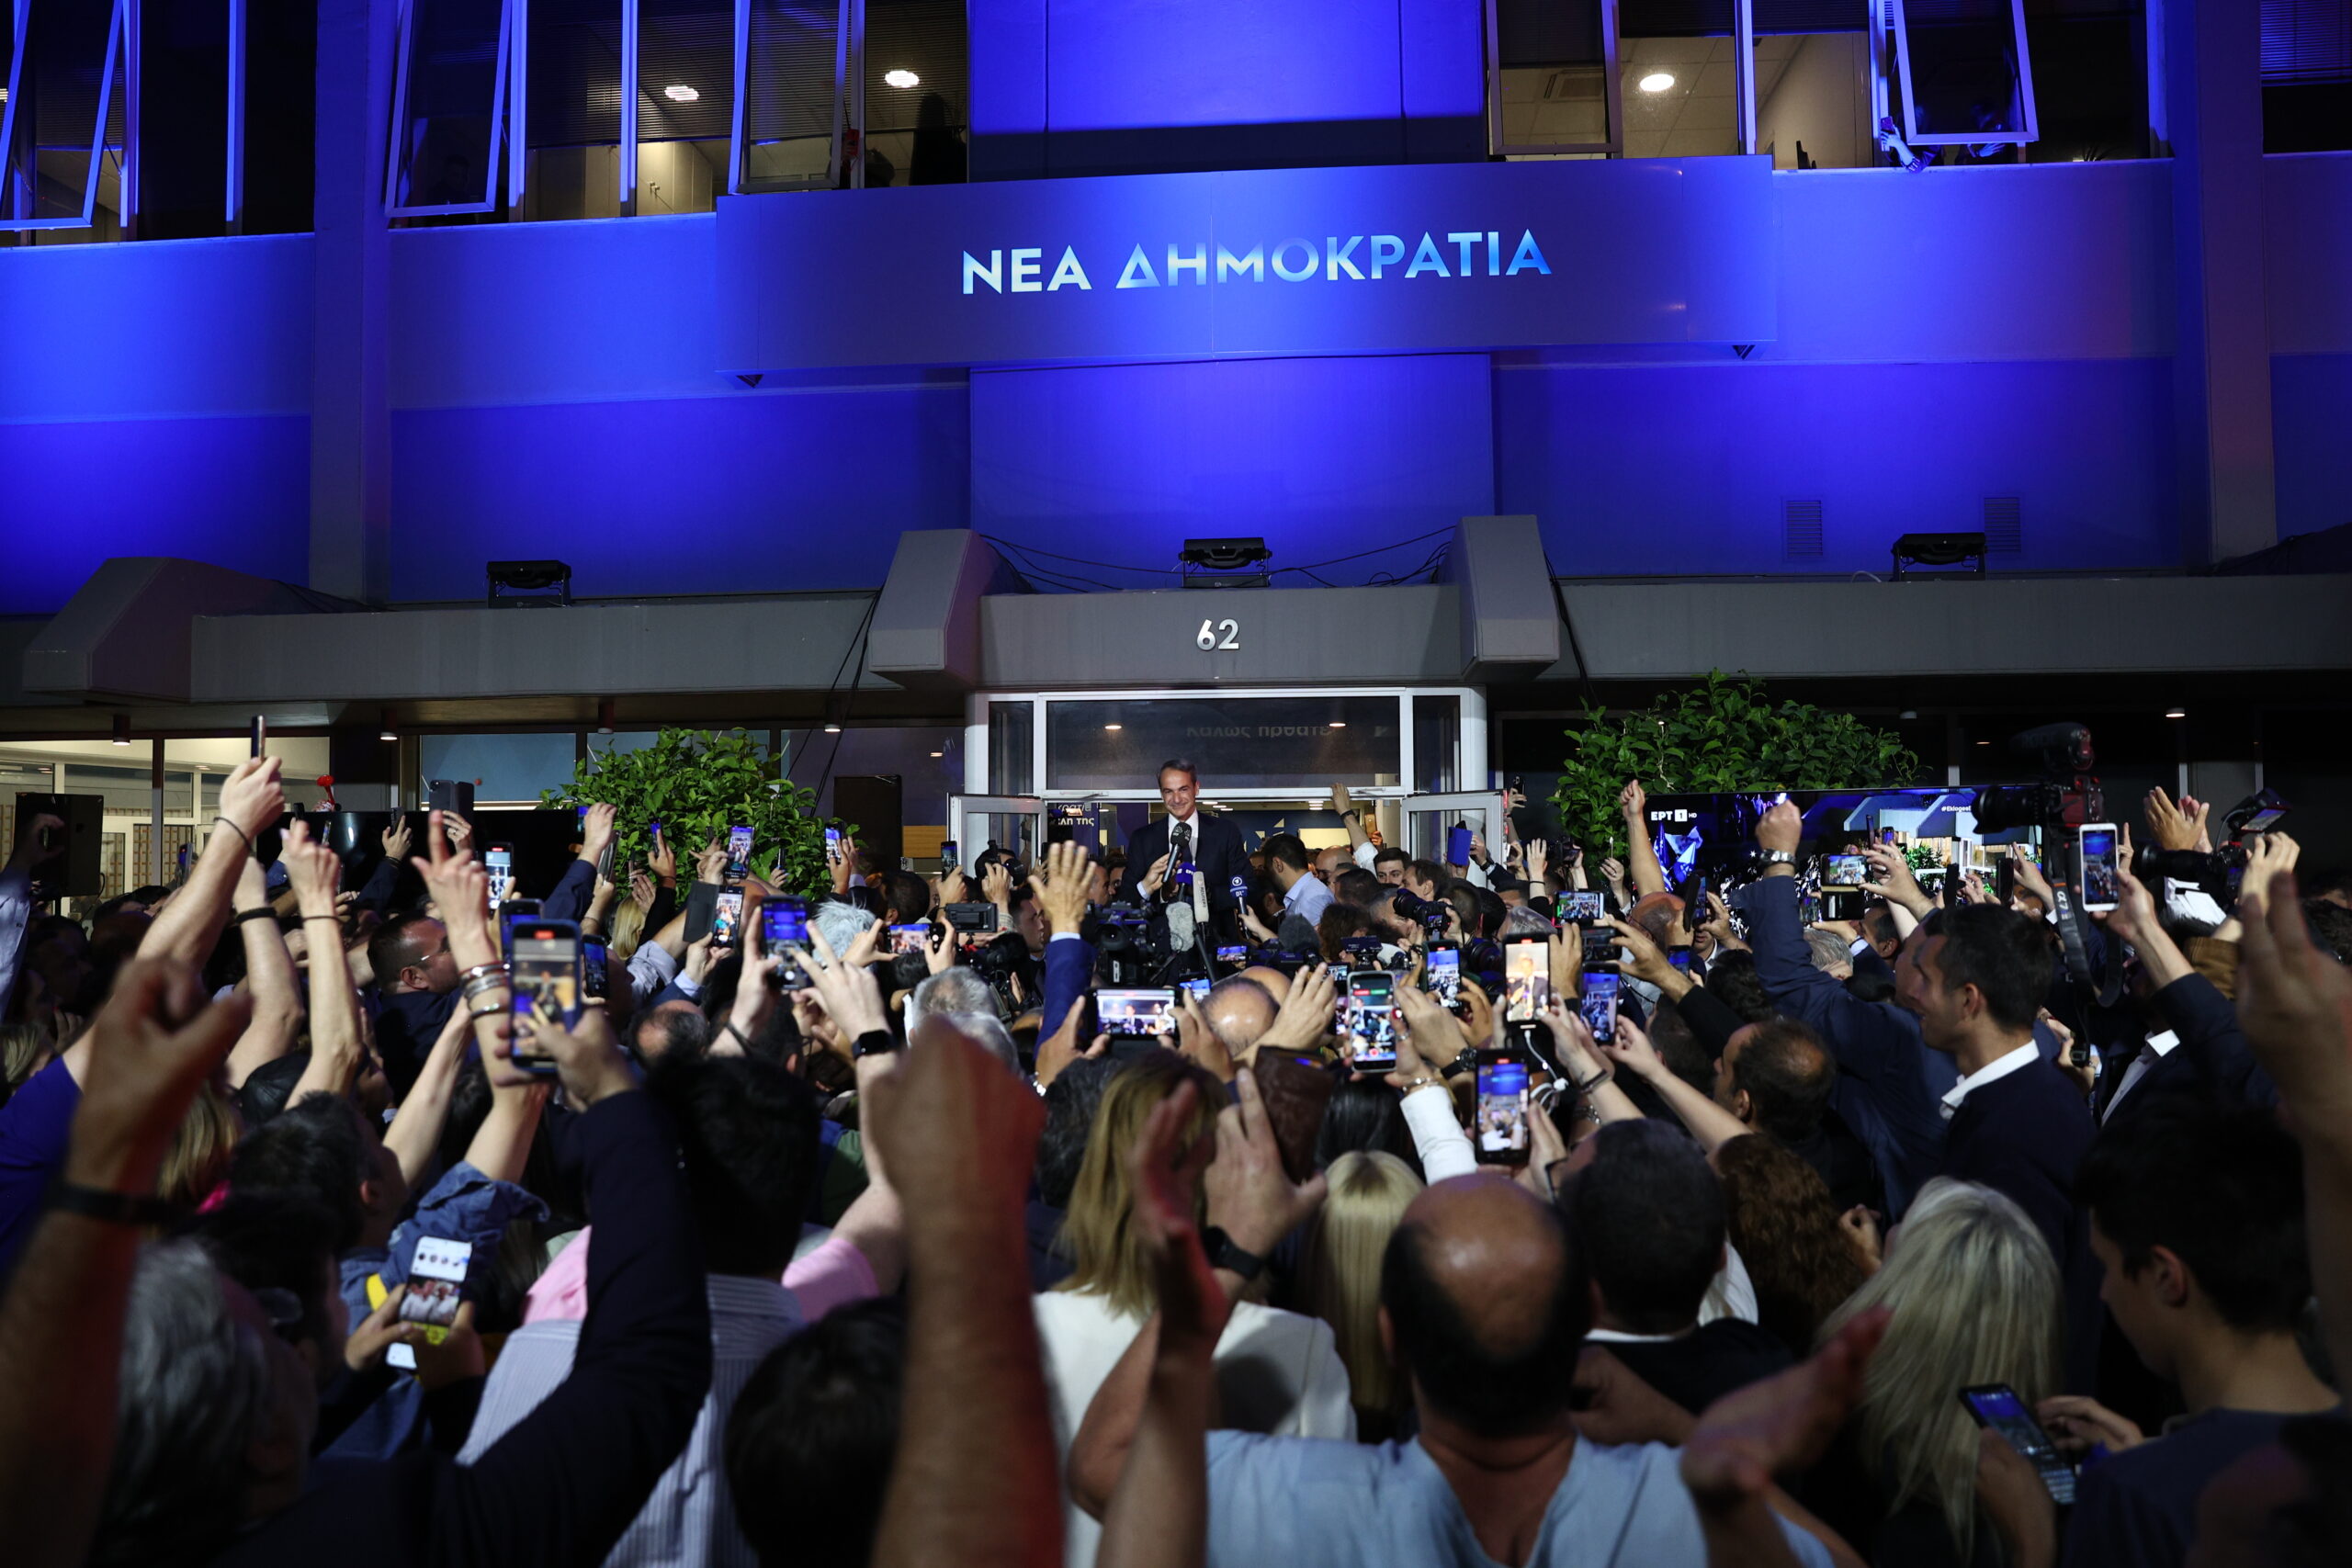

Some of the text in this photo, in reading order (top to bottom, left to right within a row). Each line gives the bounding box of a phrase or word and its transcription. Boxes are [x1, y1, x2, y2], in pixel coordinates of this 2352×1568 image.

[963, 229, 1552, 295] ΝΕΑ ΔΗΜΟΚΡΑΤΙΑ
[1197, 619, 1239, 650] 62
[1651, 810, 1673, 821] ΕΡΤ
